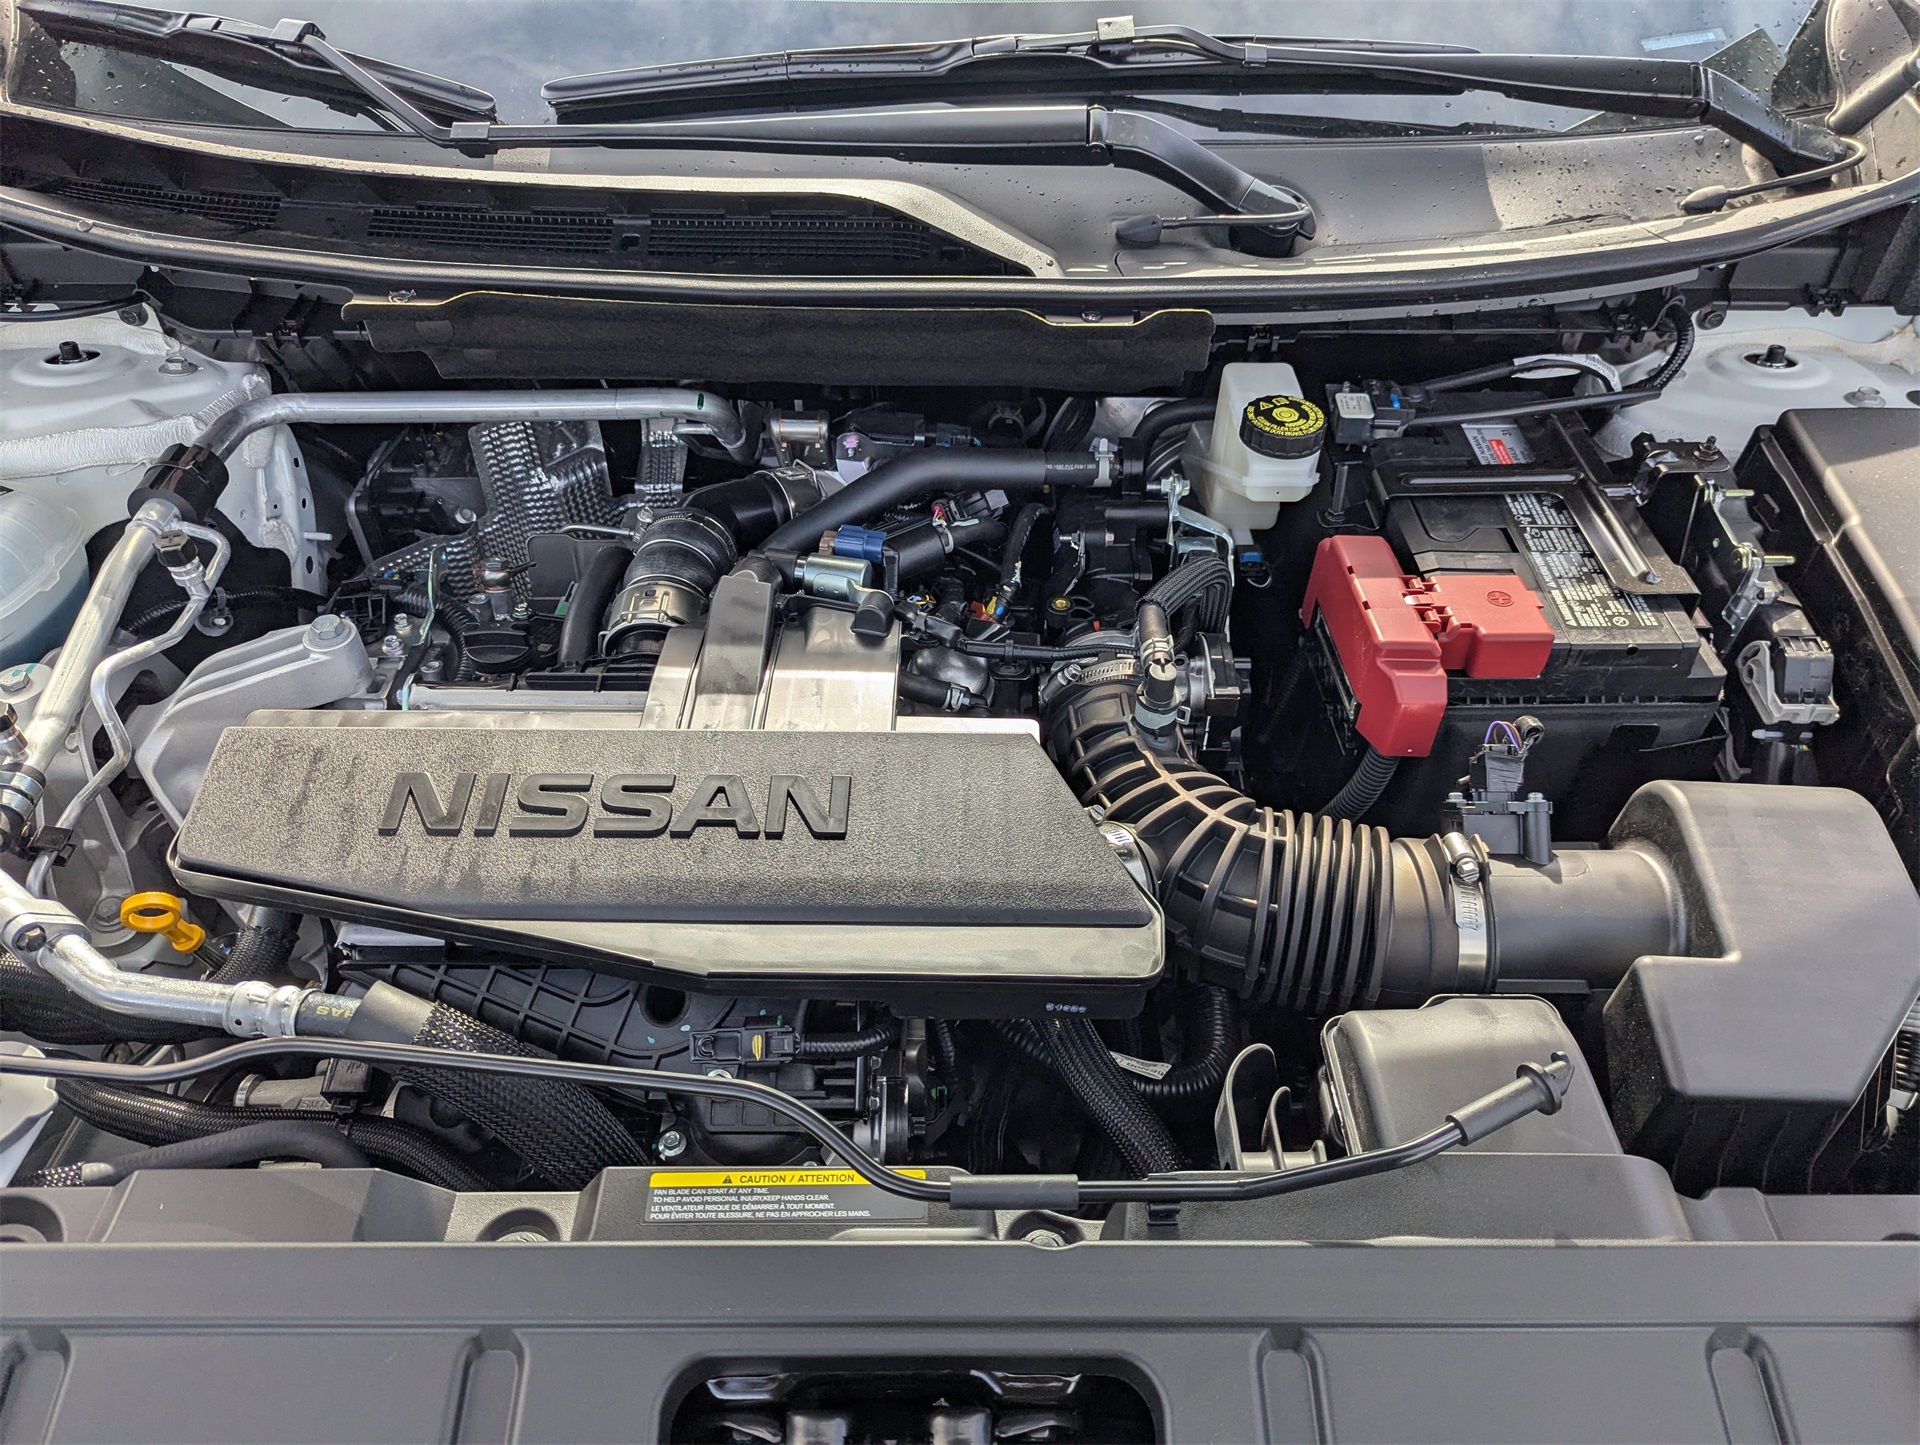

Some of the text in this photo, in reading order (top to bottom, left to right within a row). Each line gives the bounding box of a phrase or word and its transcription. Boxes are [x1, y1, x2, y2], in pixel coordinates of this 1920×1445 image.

[378, 772, 852, 840] NISSAN
[739, 1174, 855, 1184] CAUTION / ATTENTION
[651, 1204, 660, 1212] LE
[742, 1202, 778, 1210] DÉMARRER
[650, 1212, 670, 1220] POUR
[671, 1211, 694, 1219] ÉVITER
[717, 1211, 755, 1219] BLESSURE,
